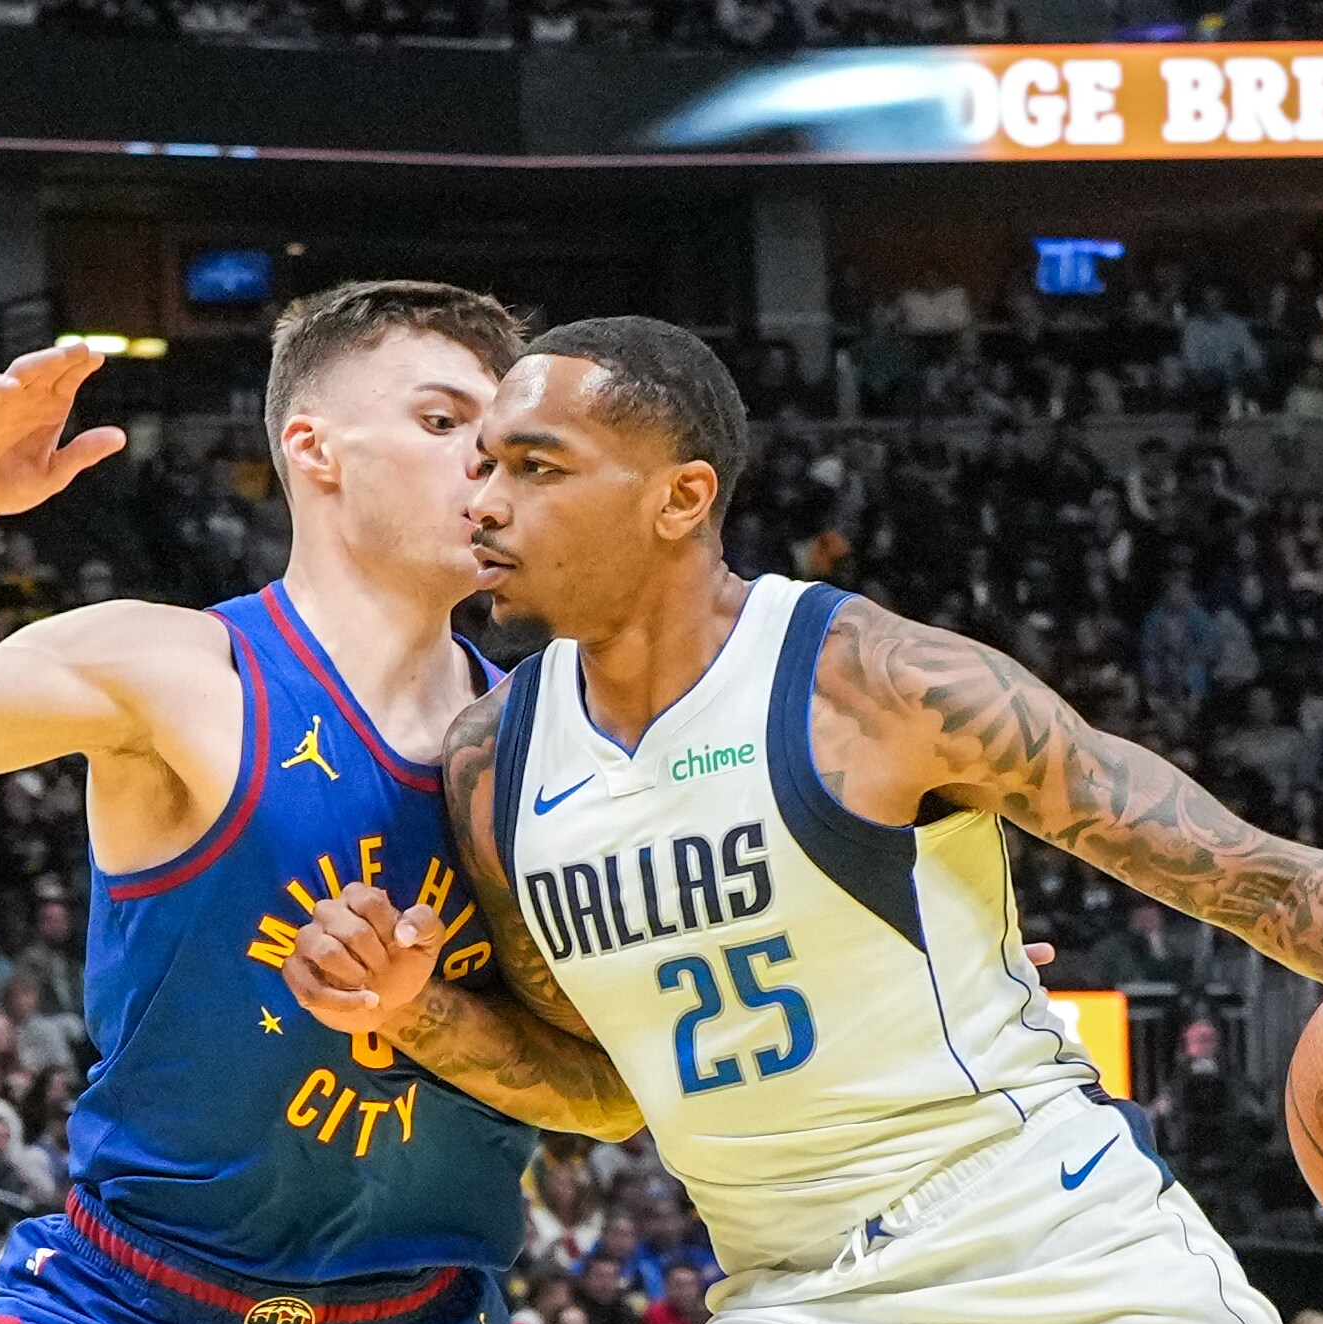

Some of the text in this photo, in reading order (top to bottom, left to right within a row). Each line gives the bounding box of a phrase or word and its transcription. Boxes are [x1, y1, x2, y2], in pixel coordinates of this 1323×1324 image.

[671, 740, 757, 783] chime
[415, 855, 494, 983] HIG
[524, 818, 776, 964] DALLAS
[655, 929, 820, 1098] 25
[285, 1066, 420, 1159] CITY
